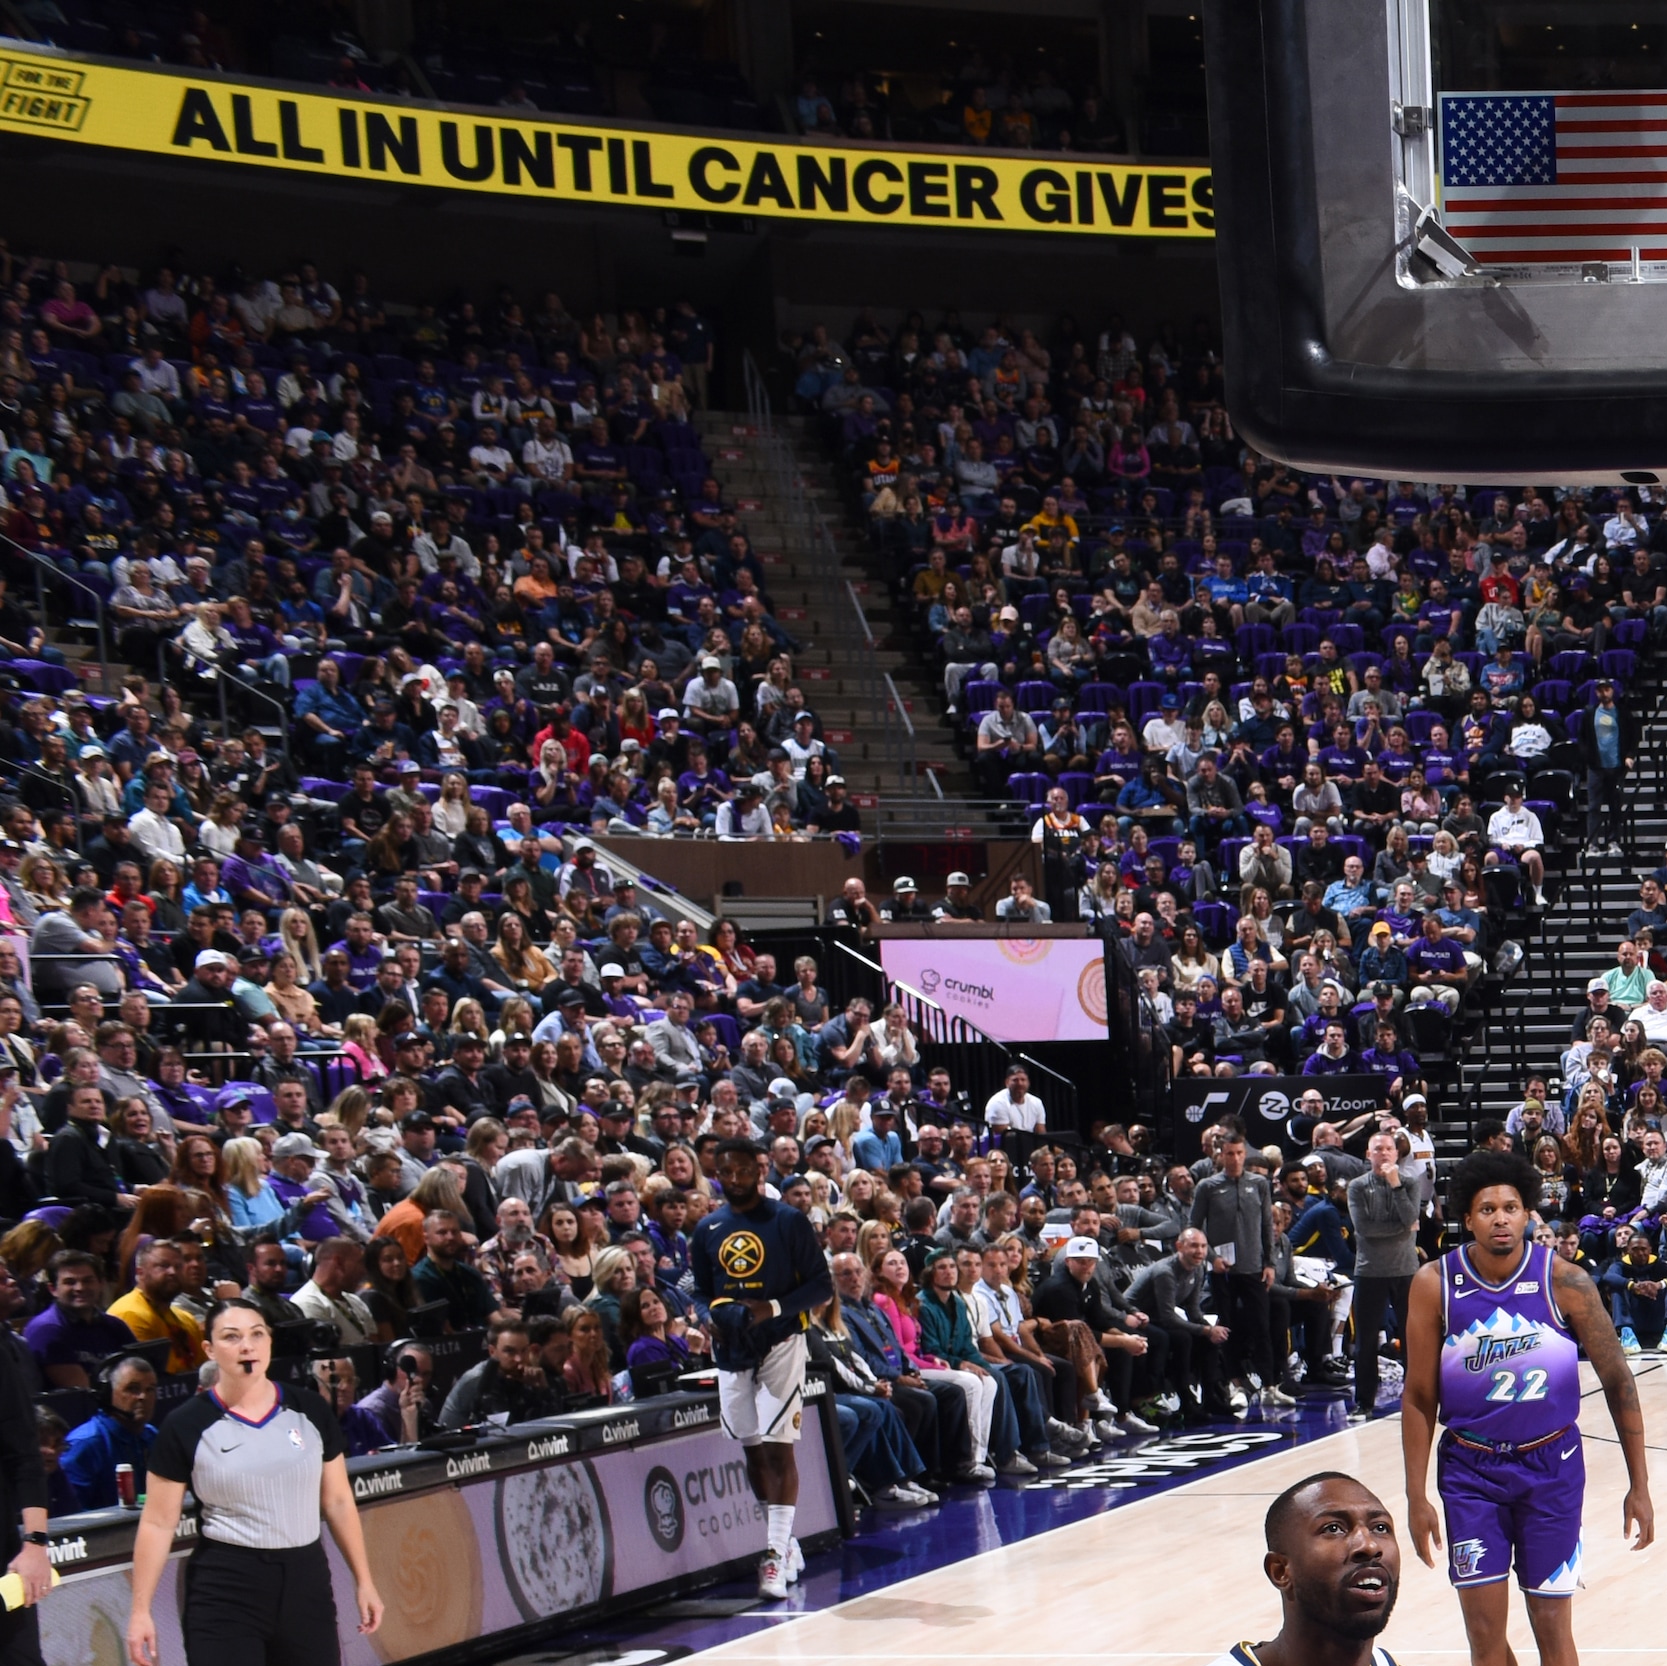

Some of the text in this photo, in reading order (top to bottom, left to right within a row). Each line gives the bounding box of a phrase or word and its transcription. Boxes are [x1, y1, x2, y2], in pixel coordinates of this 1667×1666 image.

[3, 92, 79, 122] FIGHT
[171, 87, 1216, 230] ALL IN UNTIL CANCER GIVES
[944, 978, 995, 1002] crumbl
[946, 991, 990, 1010] cookies
[1292, 1096, 1377, 1112] CnZoom
[1454, 1273, 1464, 1286] 6
[1465, 1333, 1543, 1374] JAZZ
[1486, 1369, 1549, 1403] 22
[683, 1404, 710, 1424] vivint
[612, 1419, 640, 1441] vivint
[535, 1433, 569, 1457] vivint
[1113, 1430, 1284, 1482] PACS
[456, 1450, 491, 1475] vivint
[366, 1470, 403, 1493] vivint
[685, 1463, 749, 1505] crum
[698, 1503, 765, 1538] cookie
